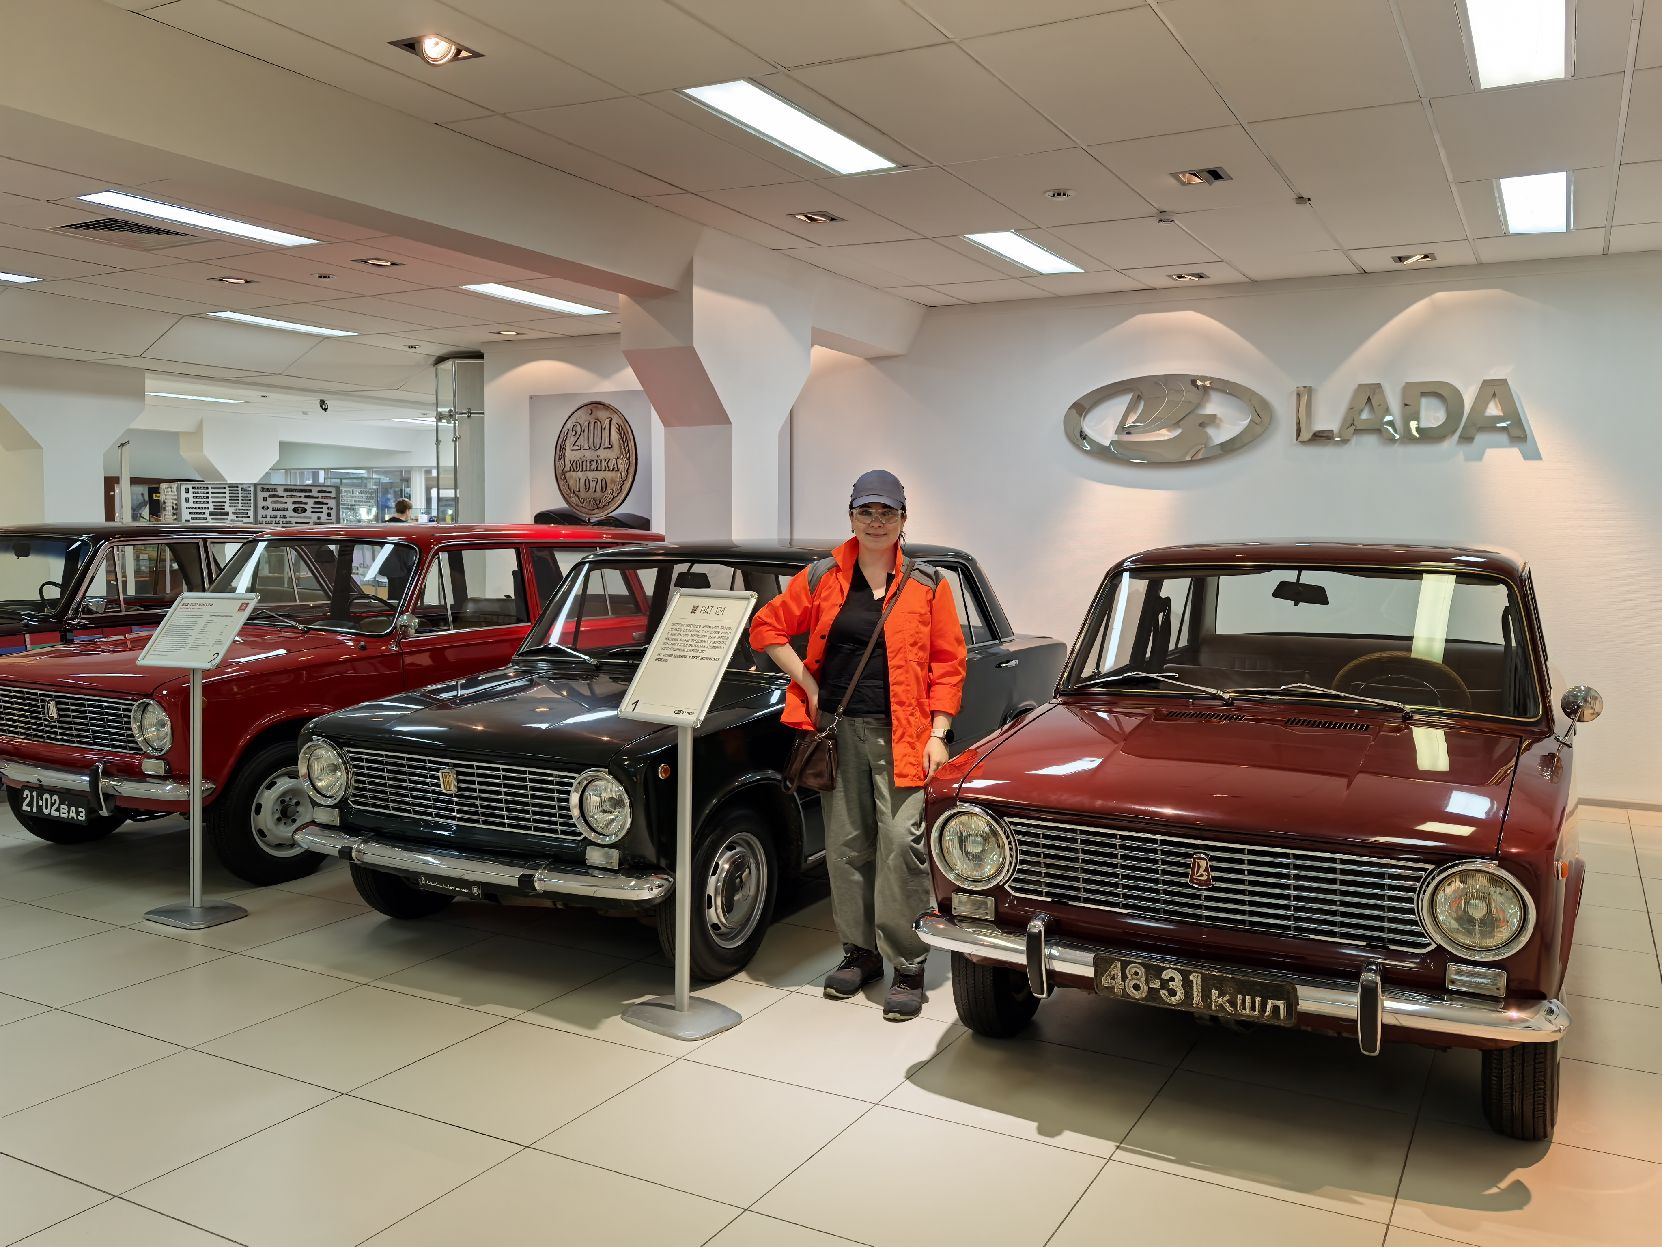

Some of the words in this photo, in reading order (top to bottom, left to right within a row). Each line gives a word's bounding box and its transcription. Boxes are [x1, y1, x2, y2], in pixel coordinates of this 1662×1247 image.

[1295, 378, 1528, 443] LADA
[570, 416, 613, 452] 2101
[566, 455, 621, 473] КОПЕЙКА
[60, 804, 86, 821] ВАЗ
[1101, 960, 1204, 1009] 48-31
